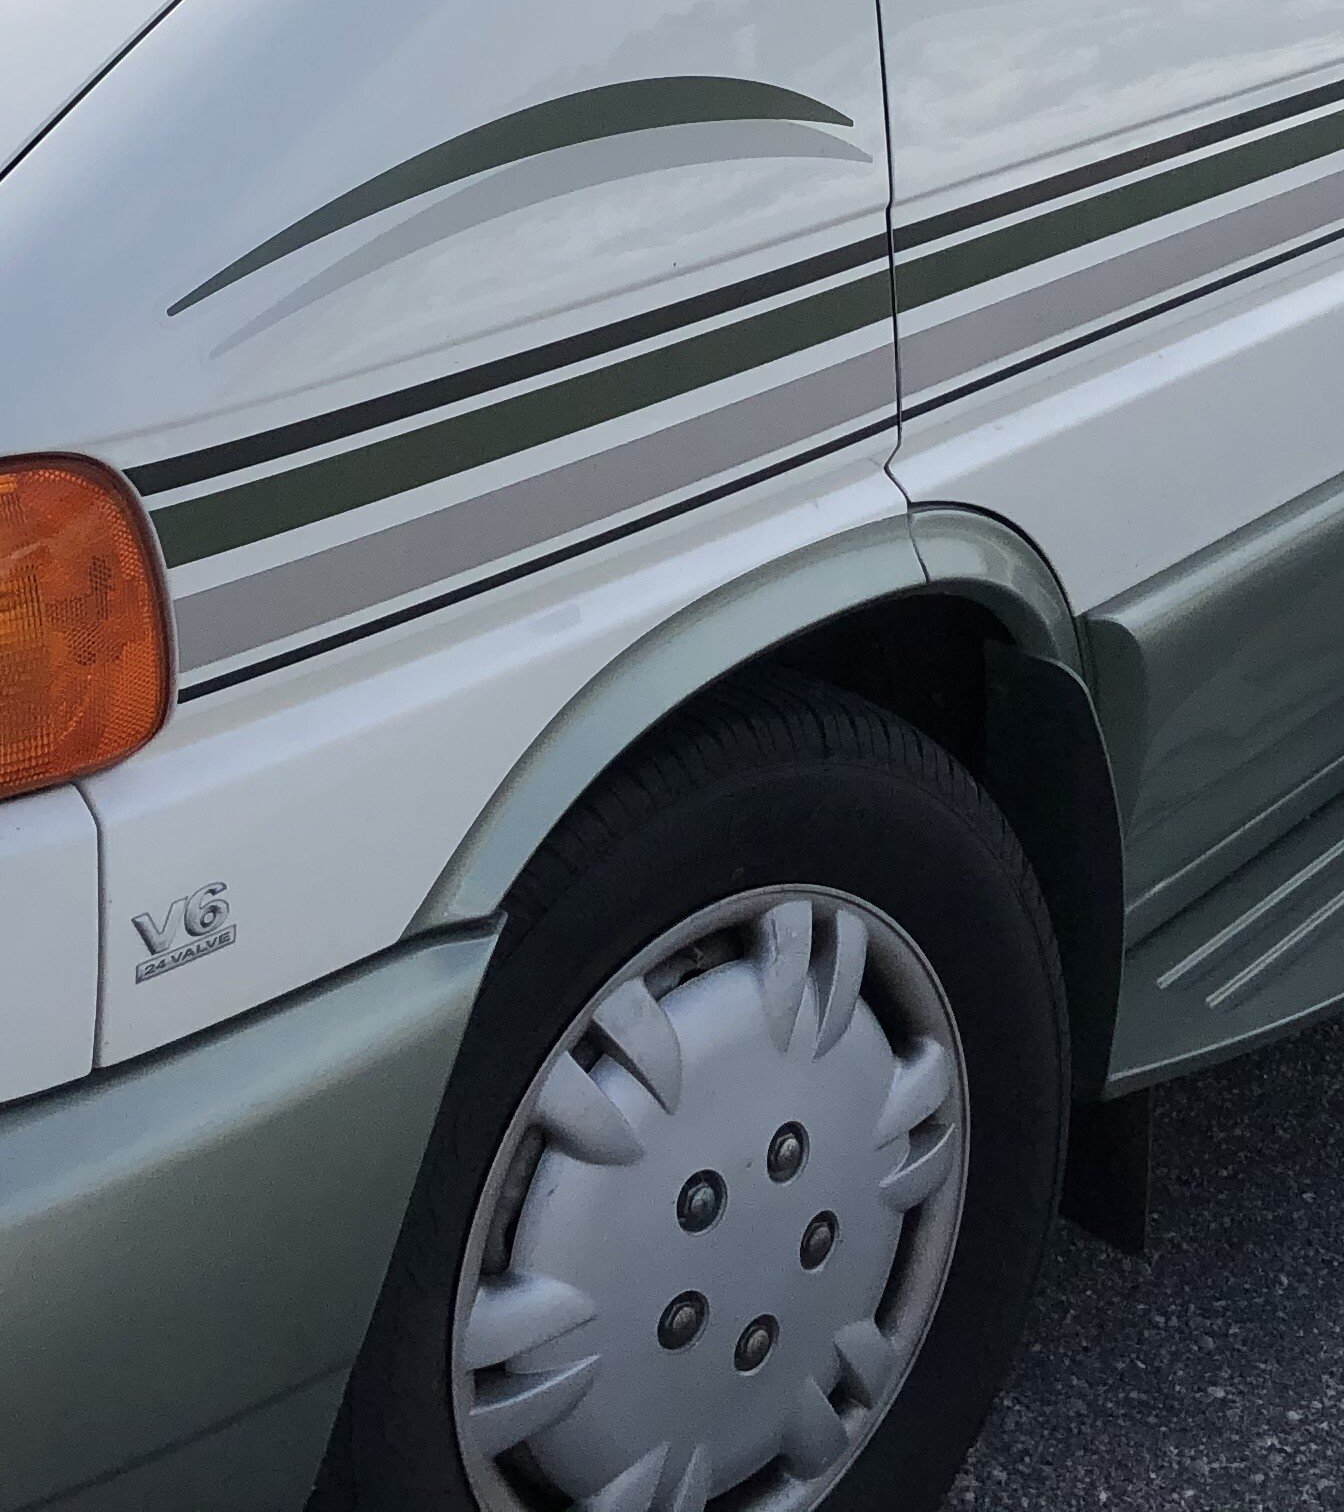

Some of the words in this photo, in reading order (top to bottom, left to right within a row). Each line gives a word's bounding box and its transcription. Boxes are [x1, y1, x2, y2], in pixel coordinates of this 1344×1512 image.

[130, 881, 230, 956] V6
[144, 958, 167, 976] 24
[170, 931, 231, 964] VALVE
